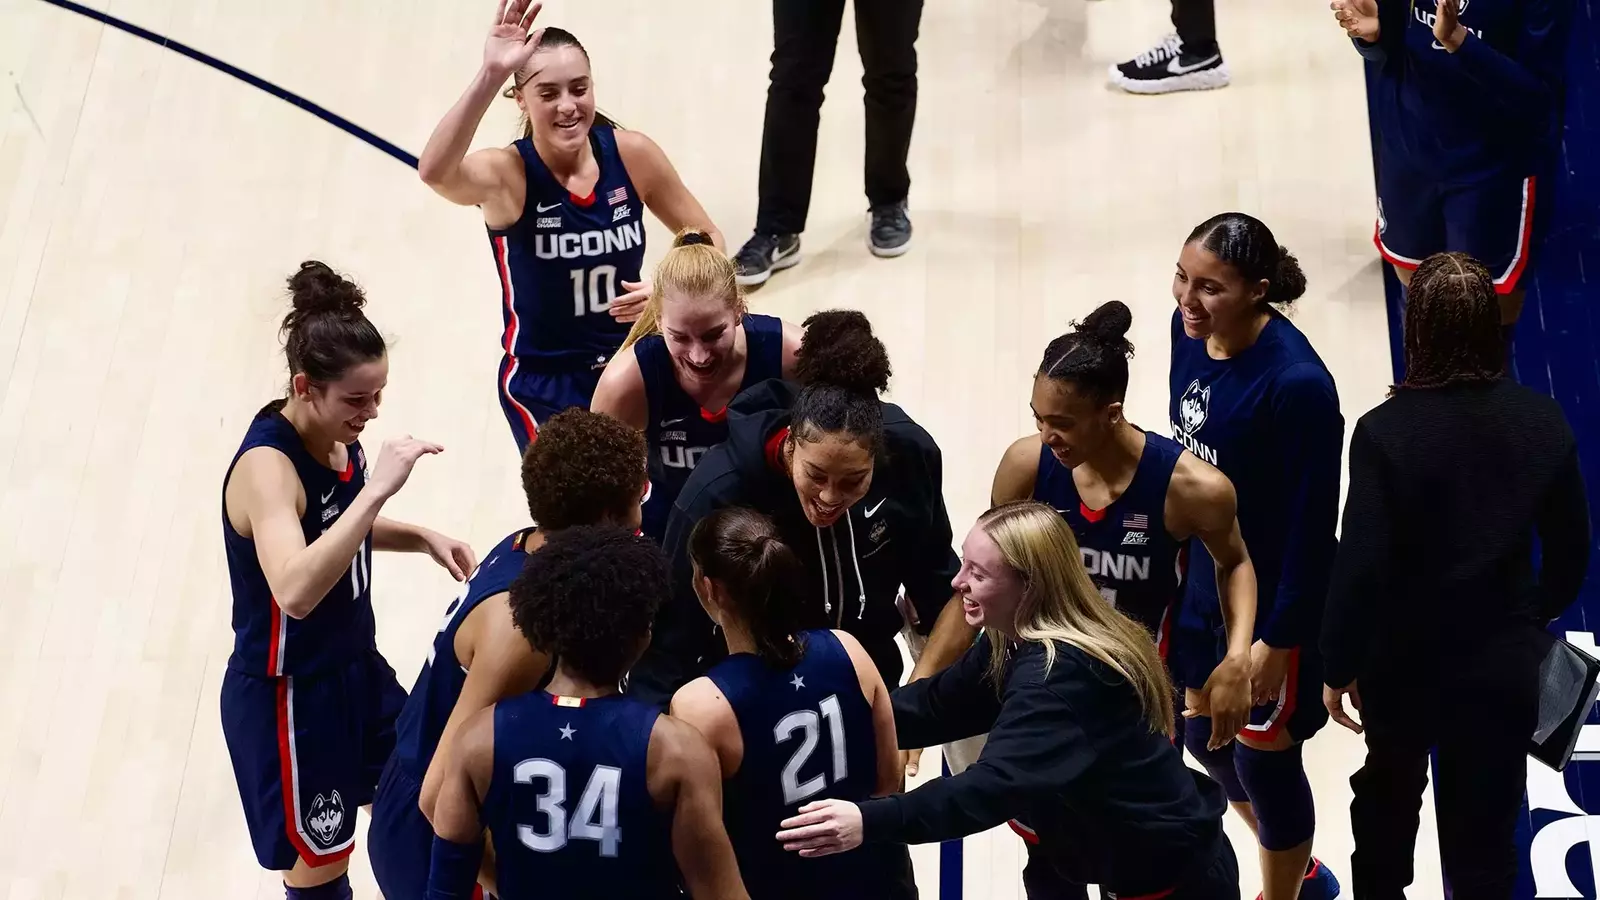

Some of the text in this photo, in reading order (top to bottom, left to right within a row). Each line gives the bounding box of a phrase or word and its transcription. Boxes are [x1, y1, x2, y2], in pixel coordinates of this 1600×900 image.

[535, 220, 642, 260] UCONN
[570, 264, 617, 317] 10
[1079, 546, 1151, 581] ONN
[1122, 537, 1150, 545] EAST
[773, 693, 849, 806] 21
[513, 757, 623, 858] 34
